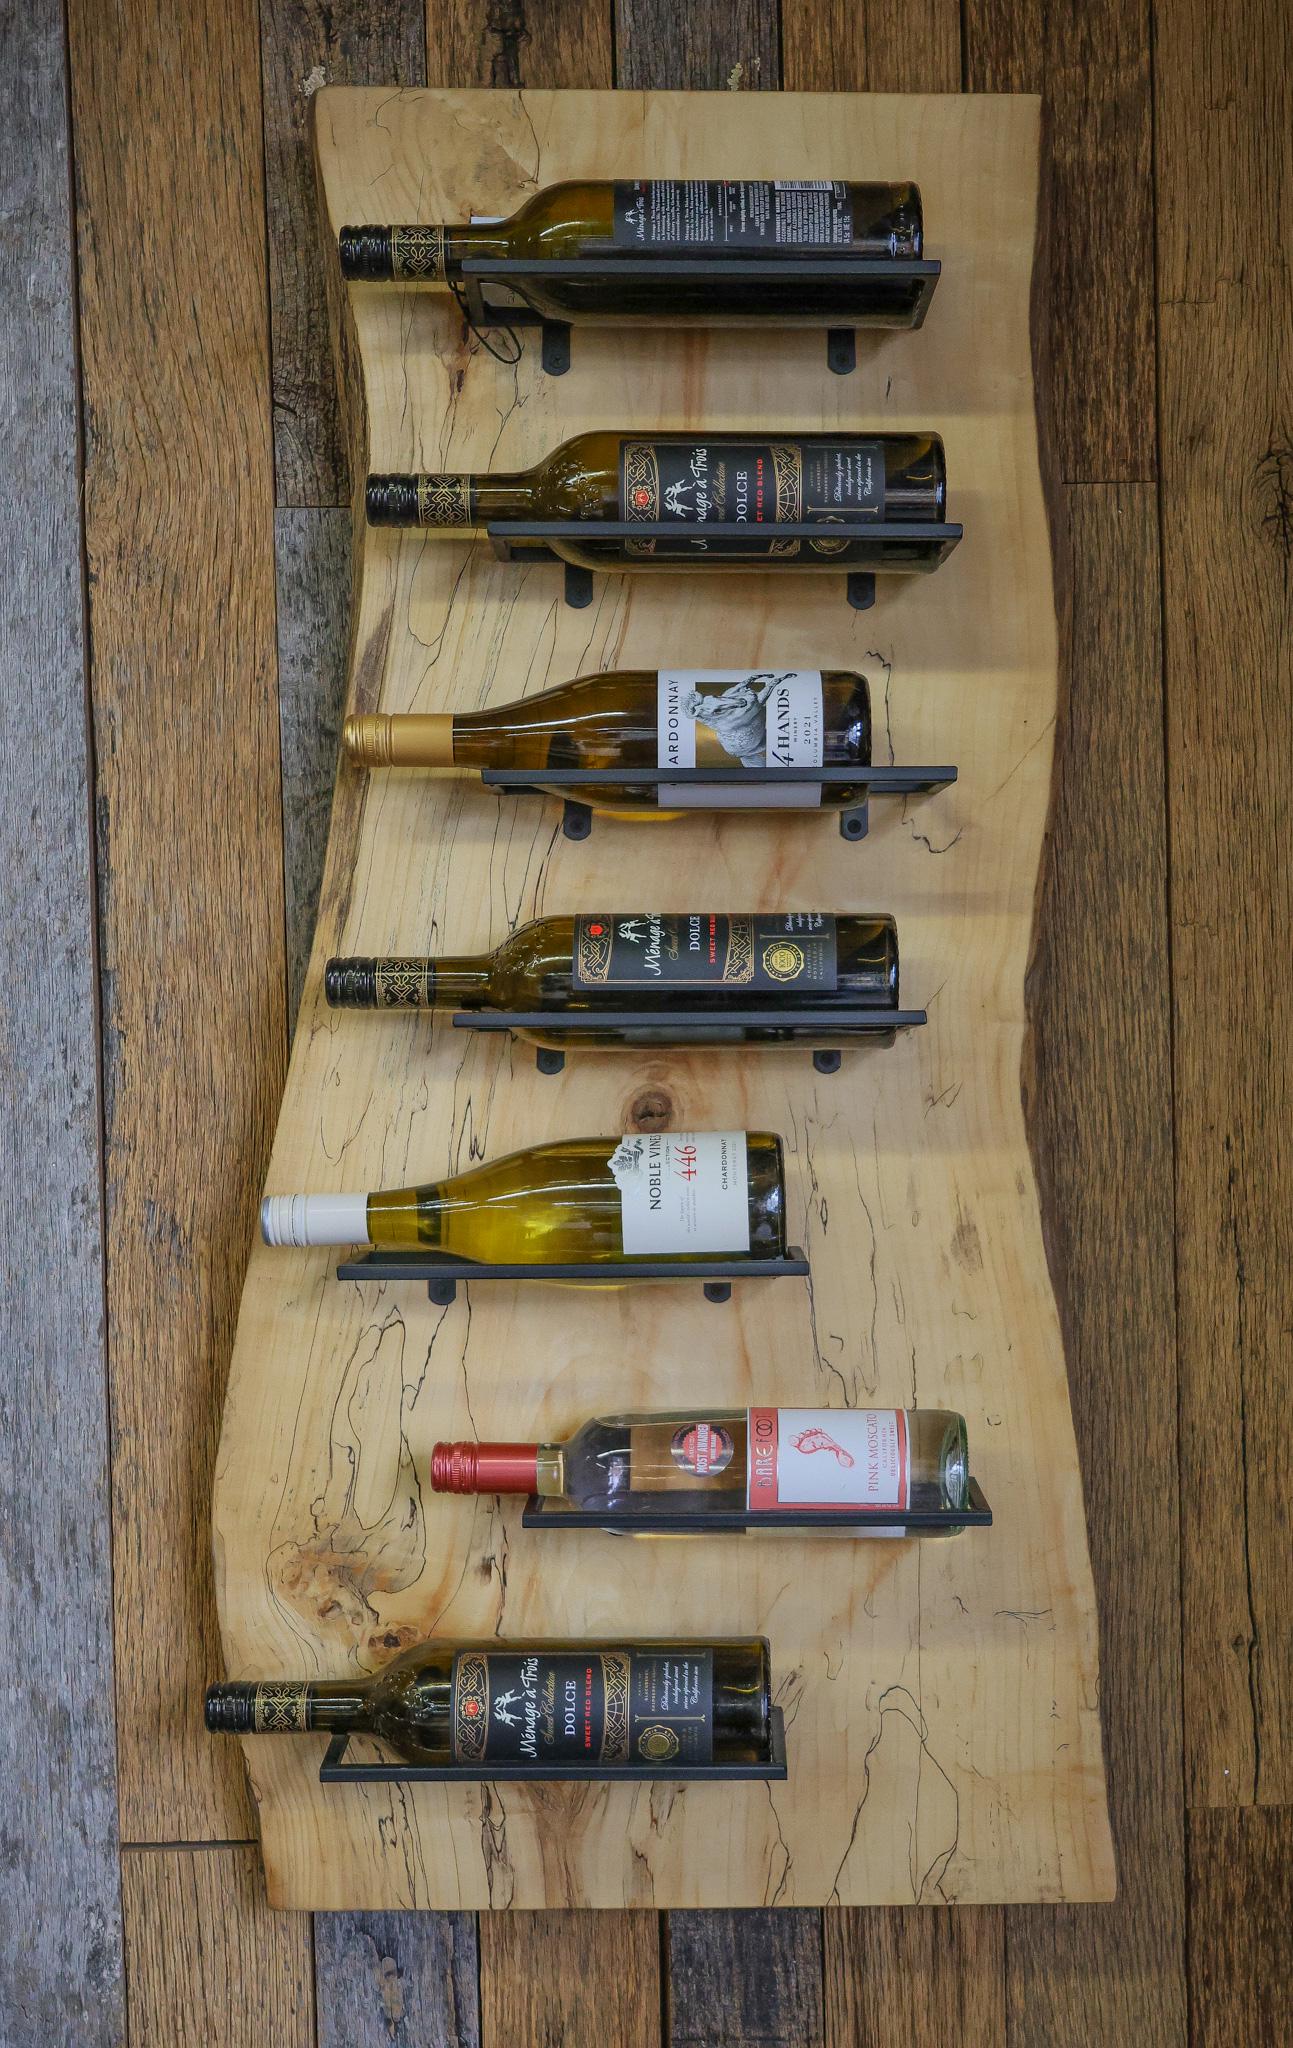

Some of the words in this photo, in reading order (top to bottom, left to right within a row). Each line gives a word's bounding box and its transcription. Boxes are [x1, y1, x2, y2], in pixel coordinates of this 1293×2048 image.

[690, 448, 708, 478] Trois
[692, 479, 707, 489] à
[711, 462, 728, 504] Collection
[668, 679, 678, 765] ARDONNAY
[777, 688, 790, 749] HANDS
[772, 751, 794, 768] 4
[689, 916, 700, 950] DOLCE
[644, 925, 666, 976] Ménage
[649, 1135, 662, 1158] VINES
[672, 1144, 697, 1182] 446
[649, 1163, 662, 1210] NOBLE
[697, 1424, 709, 1452] AWARDED
[755, 1415, 773, 1487] BAREFOOT
[866, 1413, 879, 1459] MOSCATO
[696, 1454, 708, 1472] MOST
[868, 1462, 879, 1492] PINK
[520, 1658, 538, 1688] Trois
[522, 1689, 537, 1699] à
[539, 1671, 555, 1715] Collection
[690, 1676, 700, 1705] California
[564, 1680, 576, 1736] DOLCE
[519, 1701, 541, 1758] Ménage
[540, 1714, 555, 1745] Sweet
